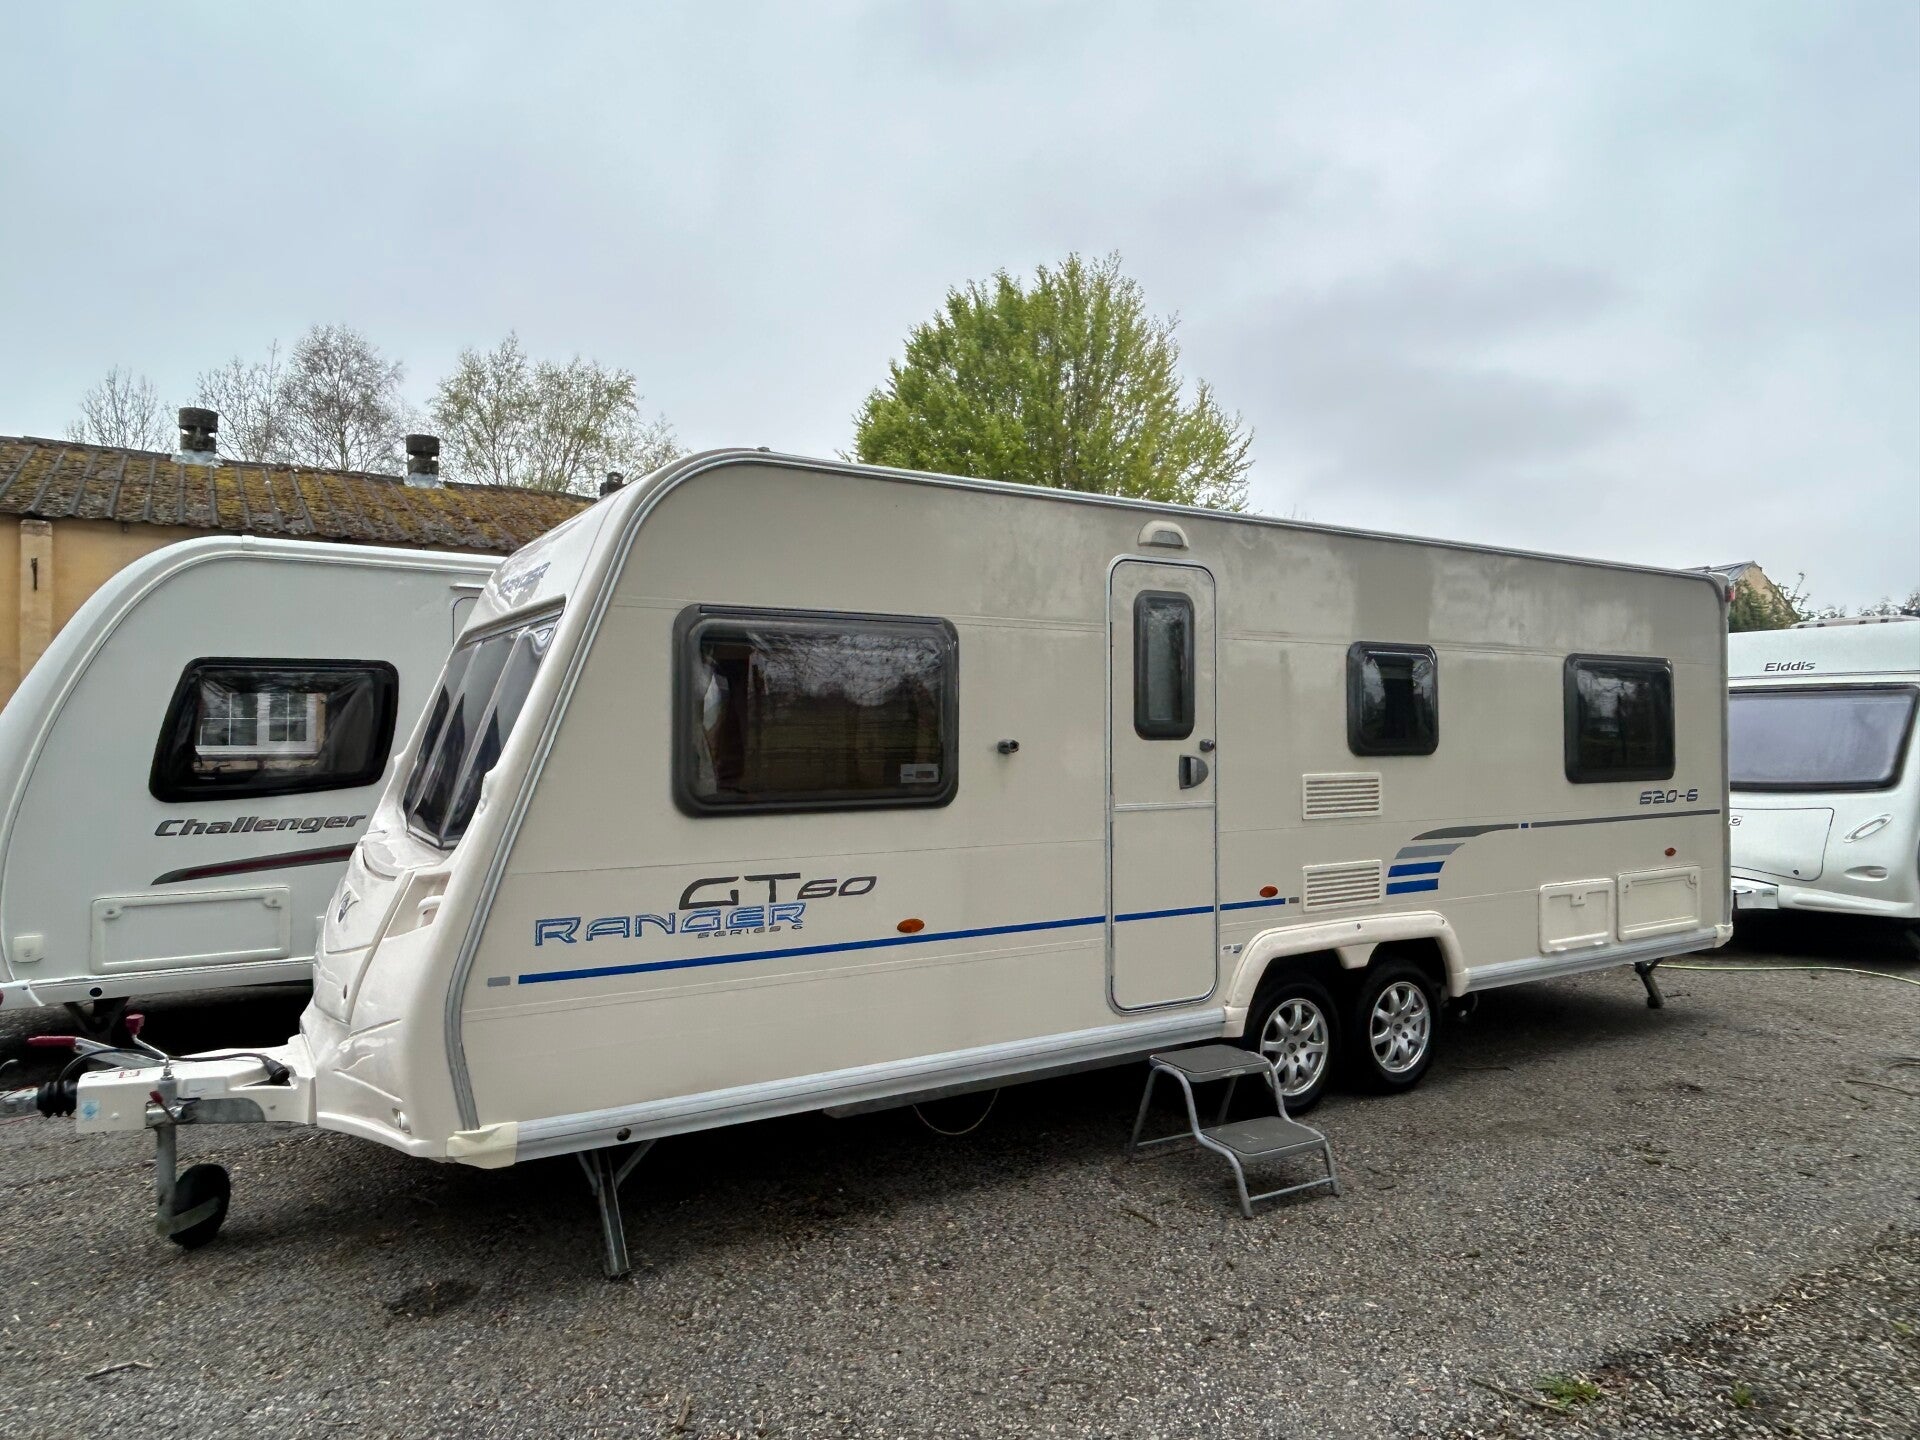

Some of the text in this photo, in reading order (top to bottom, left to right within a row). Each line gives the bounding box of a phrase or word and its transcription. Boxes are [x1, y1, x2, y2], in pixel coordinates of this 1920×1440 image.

[1764, 661, 1816, 672] Elddis
[1640, 788, 1698, 805] 620-6
[154, 814, 367, 837] Challenger
[535, 902, 807, 946] RANGER
